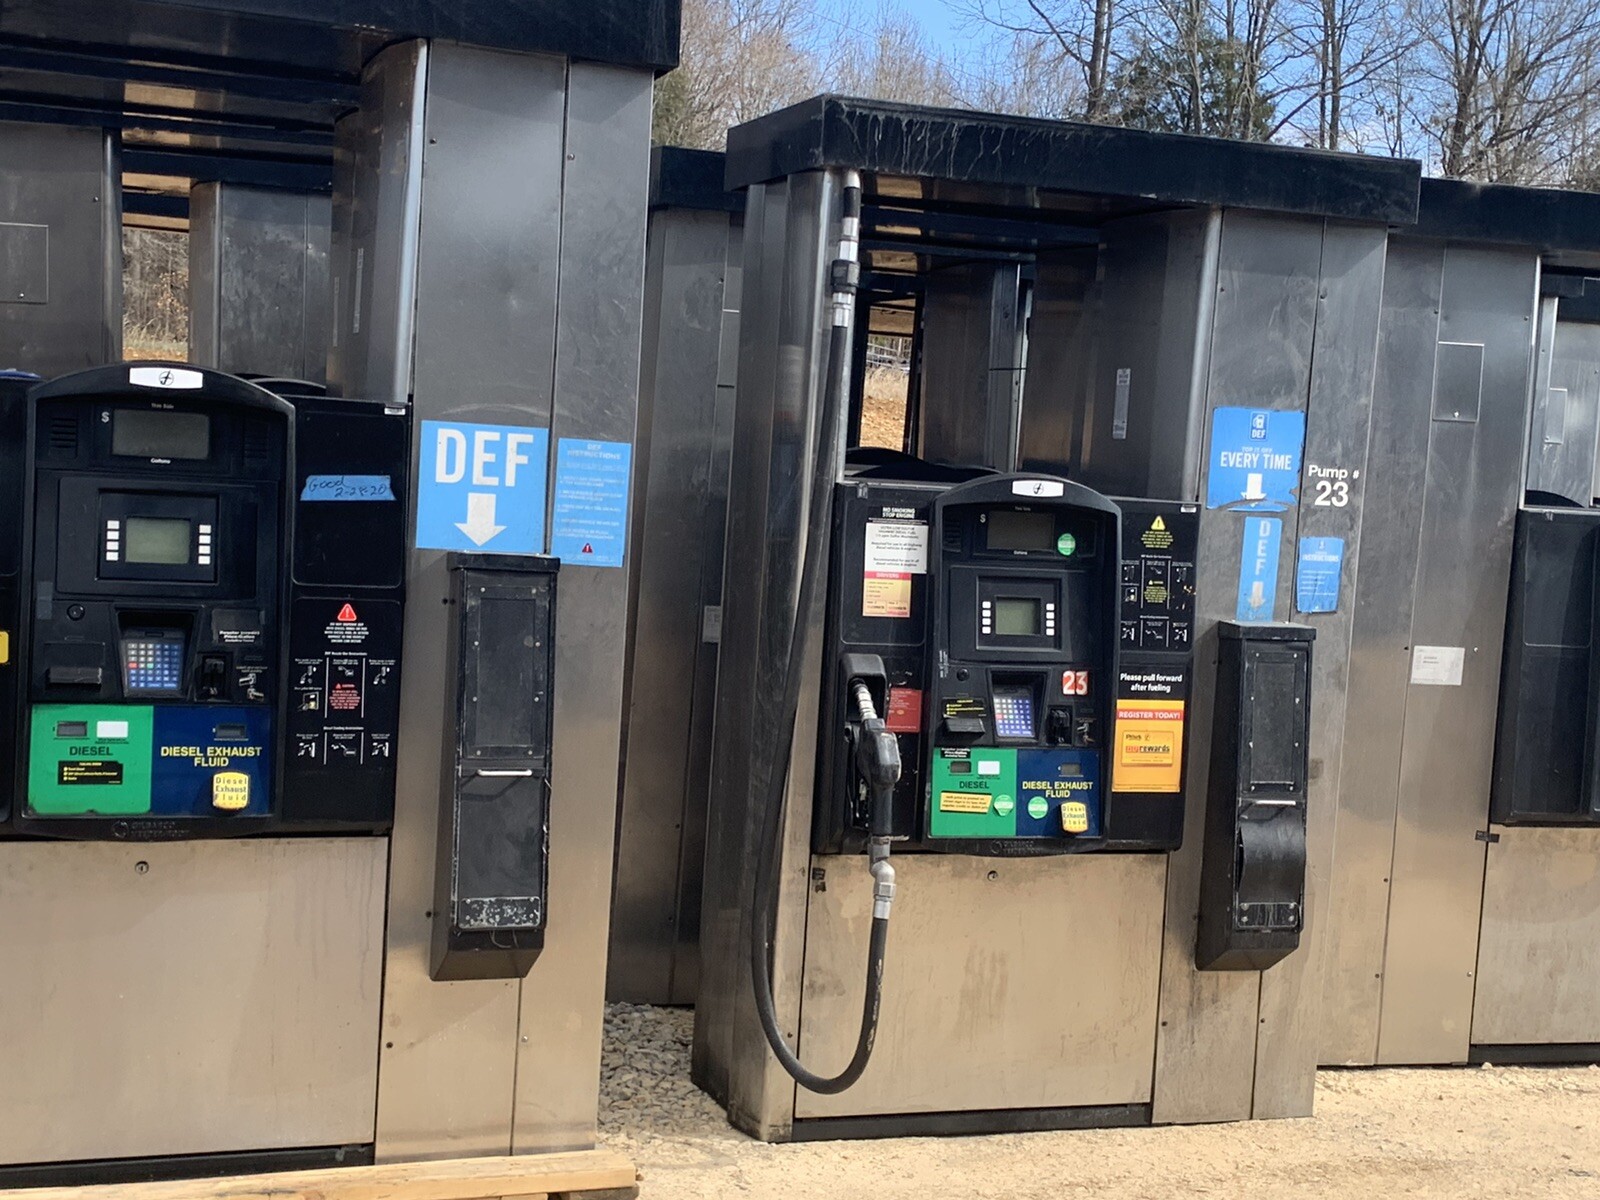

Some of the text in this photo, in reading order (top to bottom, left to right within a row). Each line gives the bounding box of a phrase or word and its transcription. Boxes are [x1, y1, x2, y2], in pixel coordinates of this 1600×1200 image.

[101, 411, 110, 423] $
[1251, 429, 1266, 439] DEF
[435, 428, 534, 487] DEF
[1220, 452, 1292, 470] EVERY TIME
[1308, 465, 1348, 480] Pump
[1314, 480, 1349, 507] 23
[1062, 670, 1088, 695] 23
[1120, 673, 1183, 684] Please pull forward
[1130, 684, 1171, 694] after fueling
[1118, 711, 1181, 720] REGISTER TODAY!
[69, 746, 114, 756] DIESEL
[160, 746, 262, 756] DIESEL EXHAUST
[194, 757, 230, 767] FLUID
[216, 776, 247, 785] Diesel
[959, 780, 990, 789] DIESEL
[1022, 780, 1094, 790] DIESEL EXHAUST
[1045, 790, 1070, 798] FLUID
